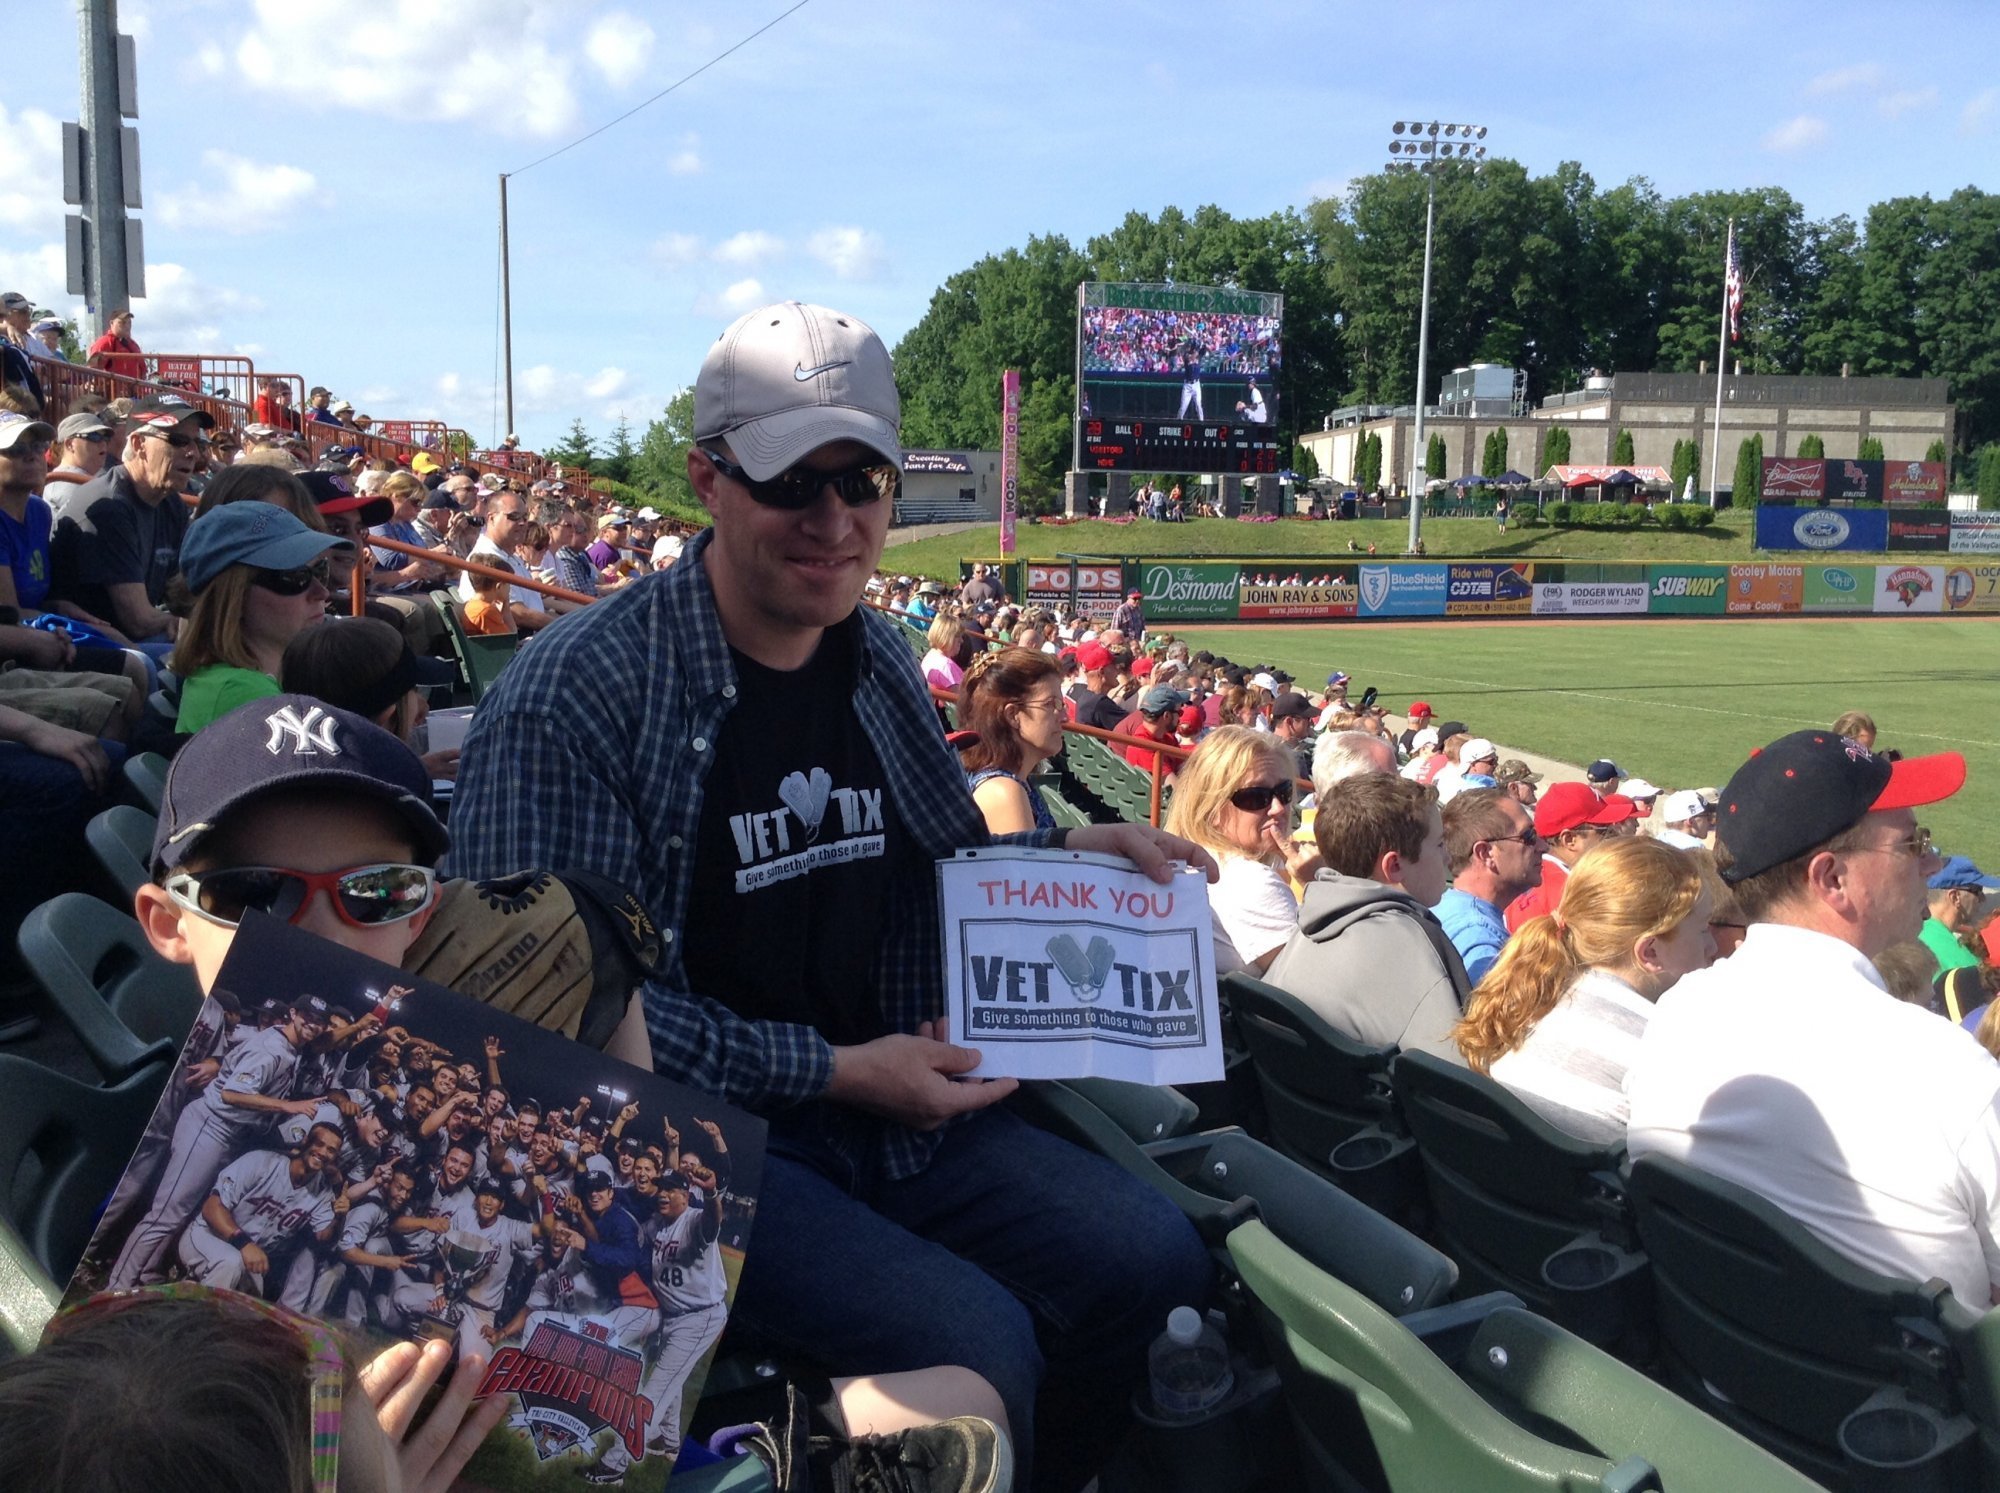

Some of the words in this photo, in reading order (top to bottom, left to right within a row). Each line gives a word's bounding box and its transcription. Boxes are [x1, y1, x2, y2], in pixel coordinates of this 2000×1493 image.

[1115, 425, 1132, 434] BALL
[1159, 427, 1181, 436] STRIKE
[1204, 428, 1217, 437] OUT
[908, 454, 950, 463] Creating
[1810, 523, 1833, 536] Ford
[1028, 569, 1121, 589] PODS
[1391, 573, 1446, 585] BlueShield
[1451, 567, 1472, 579] Ride
[1474, 567, 1493, 579] with
[1730, 566, 1765, 579] Cooley
[1768, 565, 1802, 576] Motors
[1891, 570, 1931, 586] Hannaford
[1143, 566, 1239, 600] Desmond
[1450, 581, 1491, 595] CDTA
[1570, 588, 1606, 597] RODGER
[1607, 587, 1644, 597] WYLAND
[1652, 576, 1725, 596] SUBWAY
[1243, 590, 1278, 604] JOHN
[1282, 590, 1309, 603] RAY
[1311, 590, 1320, 603] &
[1324, 589, 1354, 602] SONS
[1572, 598, 1605, 606] WEEKDAYS
[265, 704, 342, 756] NY
[729, 807, 790, 864] VET
[831, 787, 884, 834] TIX
[745, 871, 764, 886] Give
[818, 846, 849, 861] those
[978, 879, 1098, 910] THANK
[1109, 887, 1174, 918] YOU
[970, 956, 1053, 1003] VET
[1113, 963, 1193, 1011] TIX
[982, 1010, 1009, 1024] Give
[1014, 1012, 1080, 1026] something
[1085, 1012, 1096, 1022] to
[1100, 1013, 1128, 1028] those
[1131, 1017, 1152, 1032] who
[1156, 1021, 1187, 1034] gave
[660, 1267, 684, 1288] 48
[531, 1409, 557, 1420] TRI-CITY
[557, 1414, 587, 1436] VALLEYCATS
